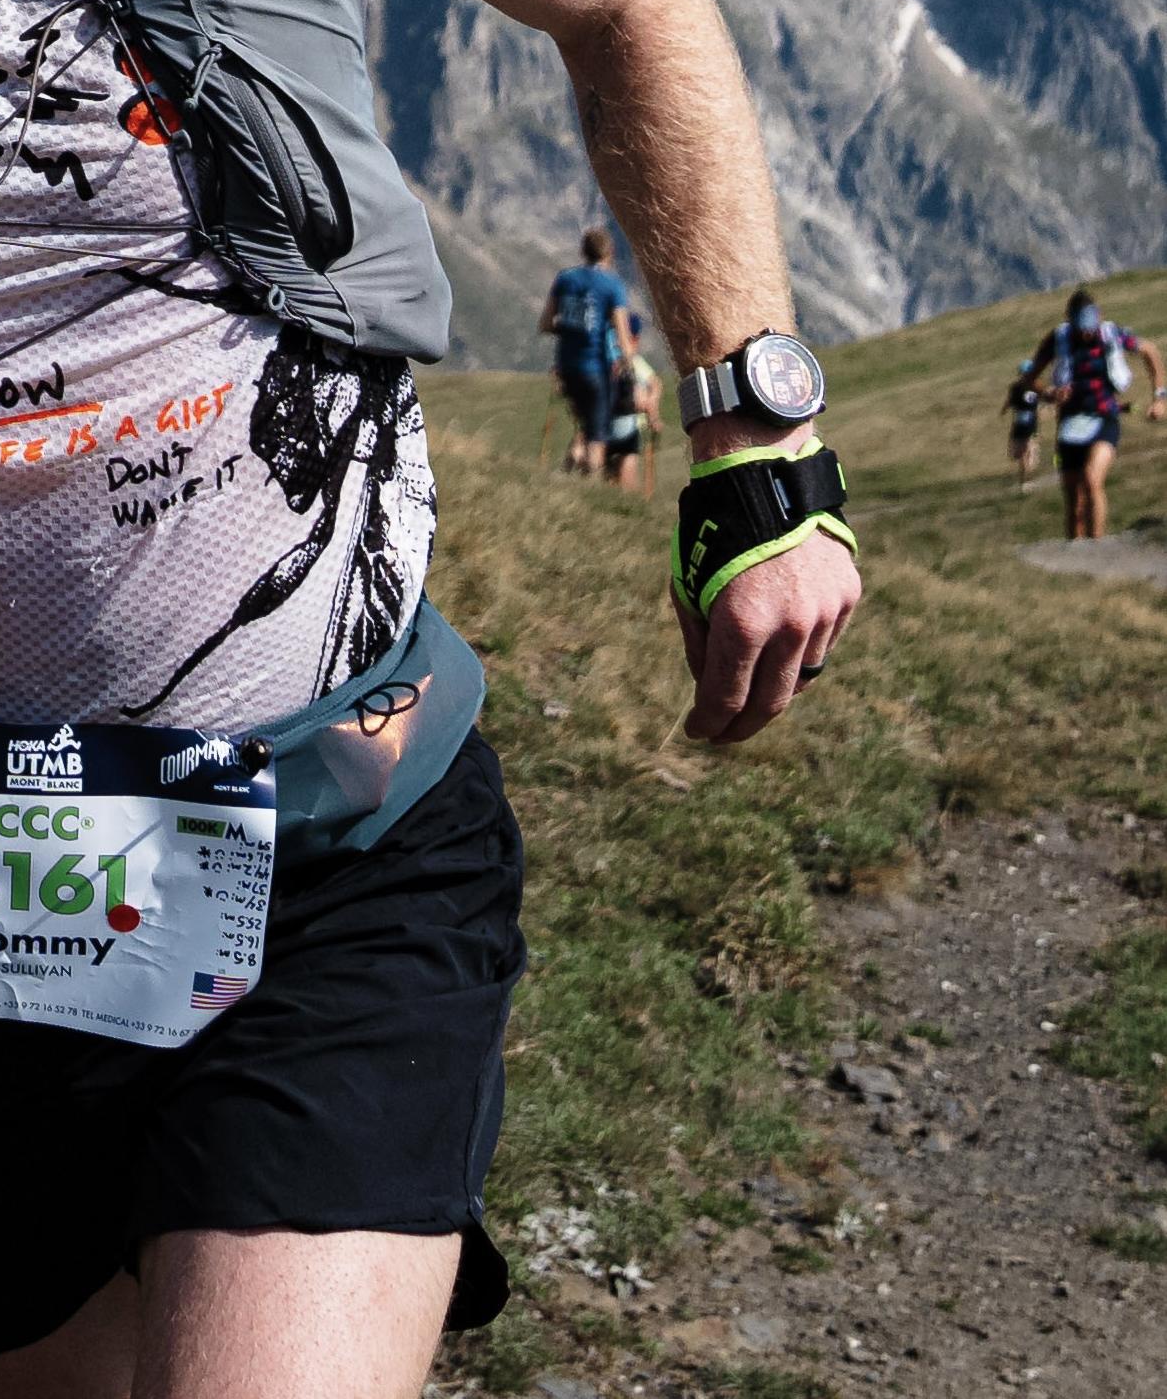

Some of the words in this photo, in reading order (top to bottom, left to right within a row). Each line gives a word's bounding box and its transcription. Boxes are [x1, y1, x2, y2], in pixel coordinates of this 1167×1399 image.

[66, 424, 98, 456] IS
[114, 415, 140, 443] A
[156, 381, 236, 434] GIFT
[112, 476, 204, 528] WAE
[215, 454, 244, 490] IT
[8, 739, 46, 752] HOKA
[7, 752, 83, 777] UTMB
[181, 818, 218, 834] 100K
[0, 962, 73, 978] SULLIVAN
[43, 1003, 53, 1013] 16
[54, 1004, 66, 1014] 52
[81, 1009, 95, 1020] TEL
